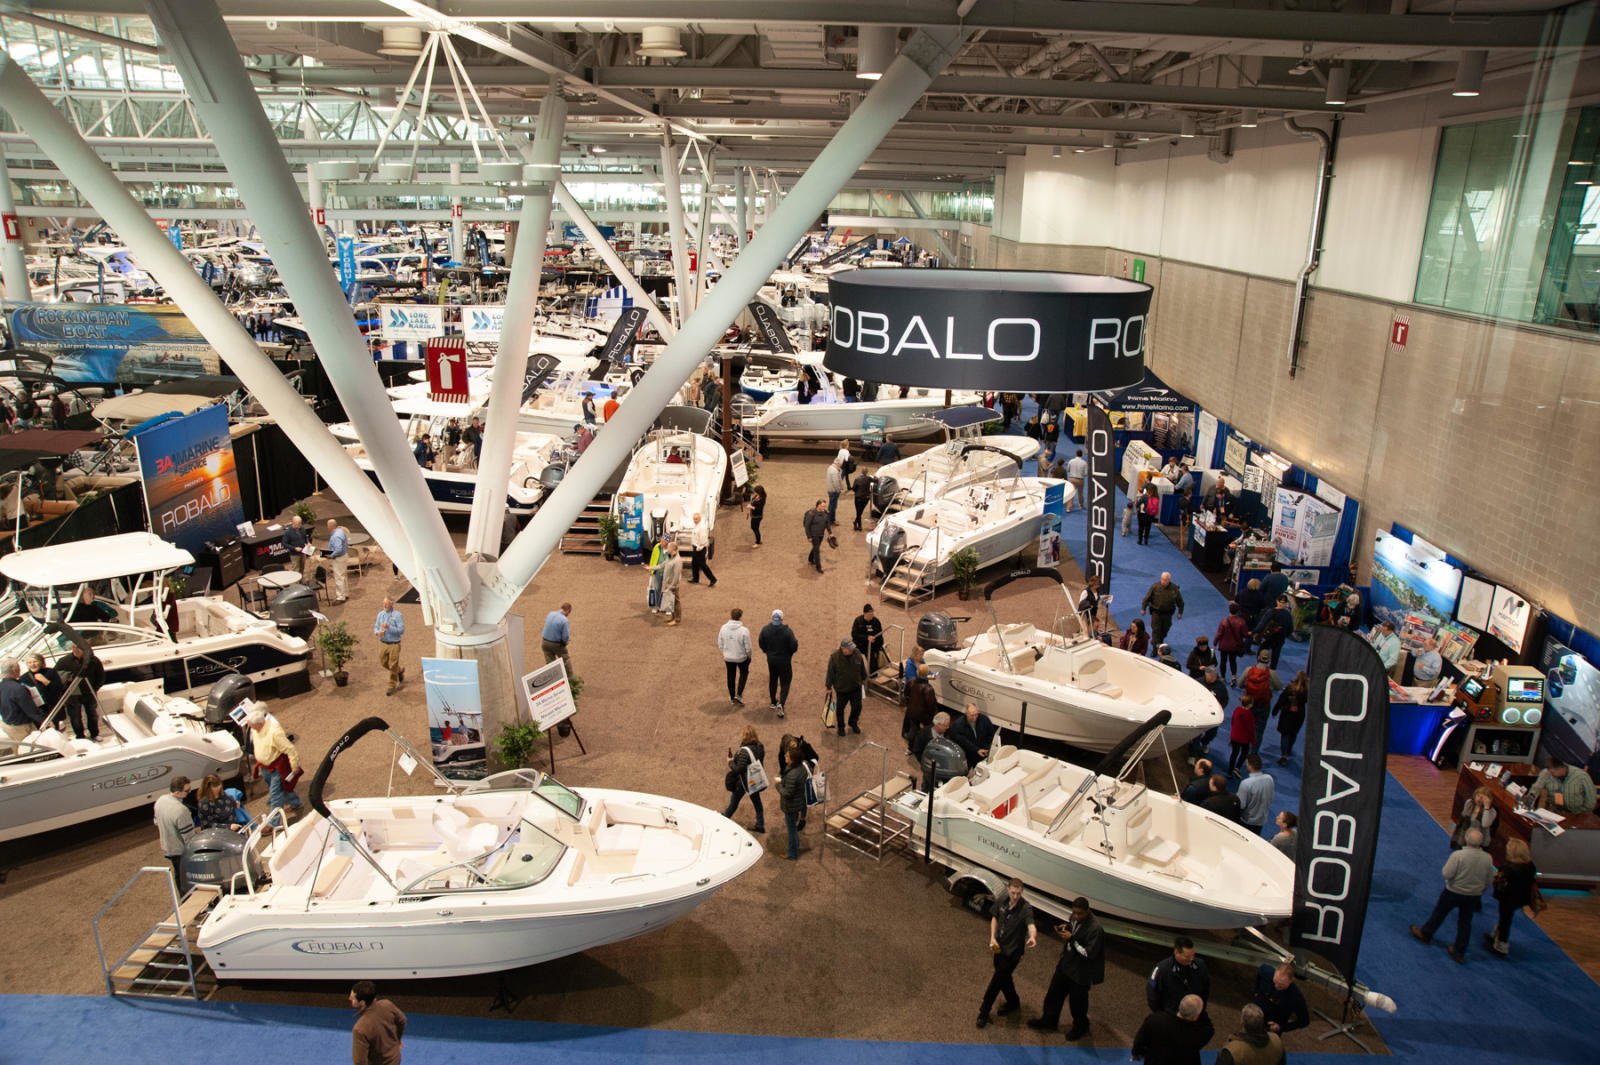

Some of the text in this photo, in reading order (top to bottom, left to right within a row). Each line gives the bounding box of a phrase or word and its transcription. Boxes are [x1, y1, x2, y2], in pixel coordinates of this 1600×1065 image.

[37, 310, 130, 326] ROCKINGHAM
[63, 324, 106, 338] BOAT
[608, 309, 640, 362] ROBALO
[1089, 315, 1148, 360] RO
[155, 437, 220, 475] 3A MARINE
[162, 484, 231, 533] ROBALO
[91, 767, 160, 792] ROBALO
[977, 835, 1021, 858] ROBALO
[192, 872, 215, 880] YAMAHA
[308, 941, 384, 952] ROBALO
